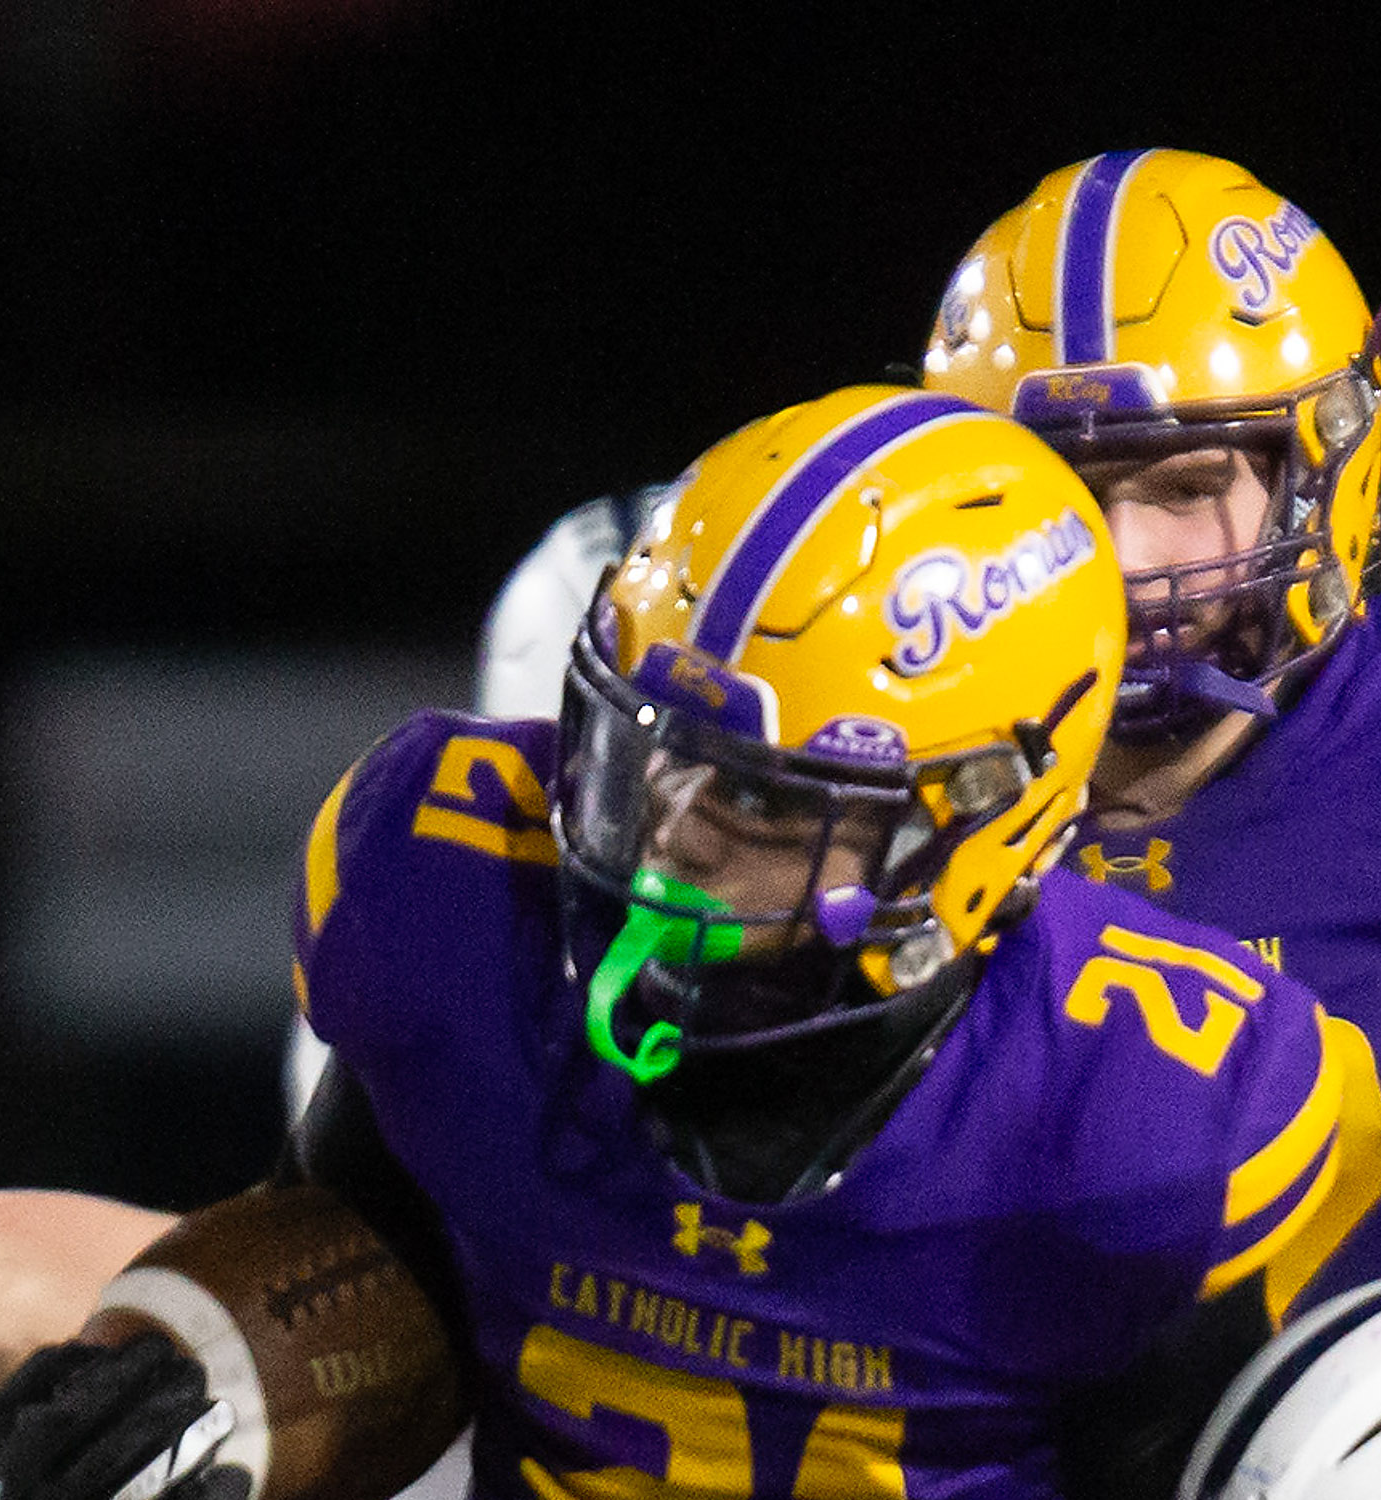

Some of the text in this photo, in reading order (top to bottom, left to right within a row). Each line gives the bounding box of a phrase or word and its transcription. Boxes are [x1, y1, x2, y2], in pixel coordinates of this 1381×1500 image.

[413, 735, 560, 866] 21
[1064, 922, 1265, 1078] 21
[549, 1263, 895, 1391] CATHOLIC HIGH
